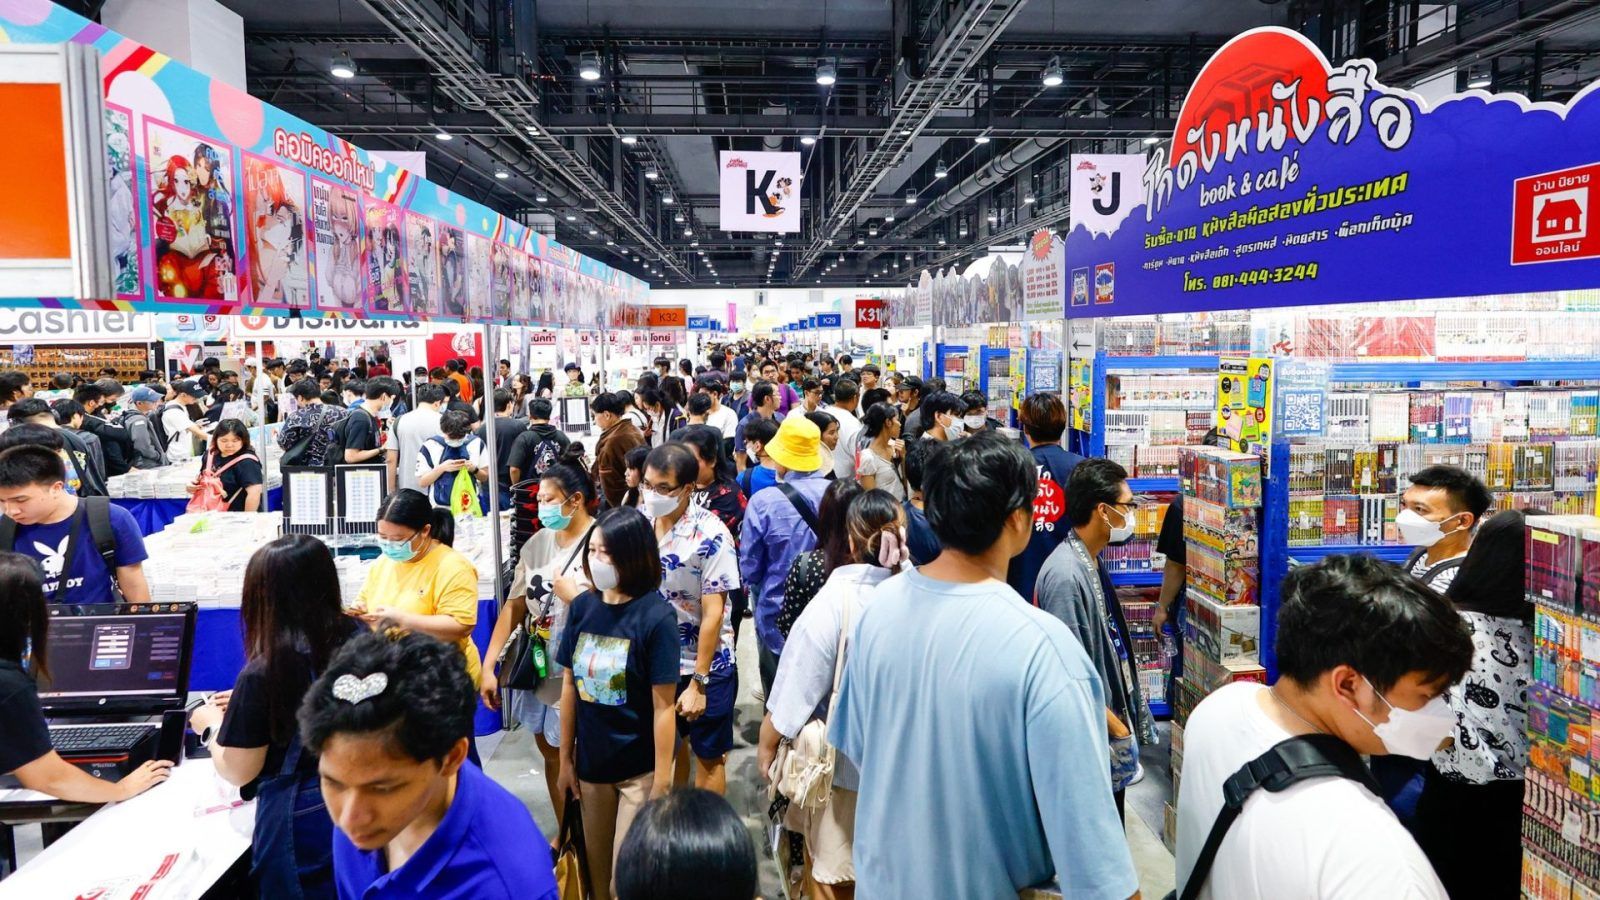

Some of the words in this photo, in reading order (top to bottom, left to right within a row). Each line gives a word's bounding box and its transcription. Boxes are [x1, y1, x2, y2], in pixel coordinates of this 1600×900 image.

[274, 127, 375, 191] คอมิคออกใหม่
[1142, 65, 1412, 222] โกดังหนังสือ
[746, 170, 776, 214] K
[1092, 172, 1120, 215] J
[1199, 175, 1237, 207] book
[1240, 172, 1252, 196] &
[1255, 151, 1299, 191] café
[1533, 181, 1555, 192] บ้าน
[1558, 174, 1590, 188] นิยาย
[1536, 241, 1581, 256] ออนไลน์
[660, 313, 678, 322] K32
